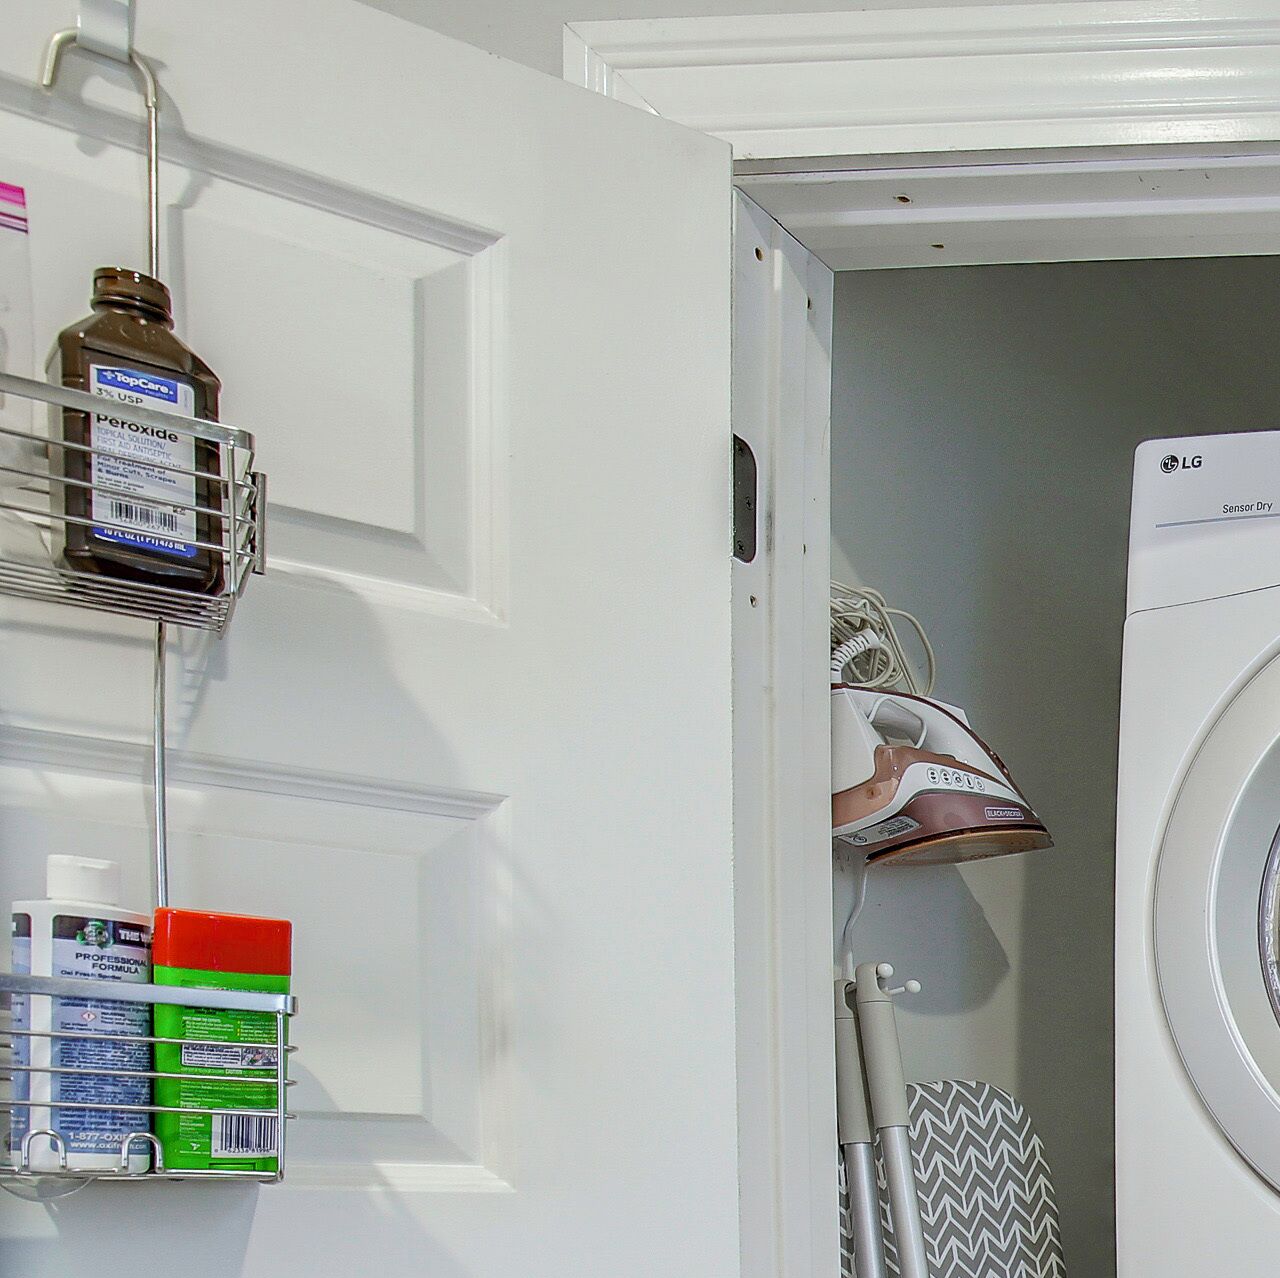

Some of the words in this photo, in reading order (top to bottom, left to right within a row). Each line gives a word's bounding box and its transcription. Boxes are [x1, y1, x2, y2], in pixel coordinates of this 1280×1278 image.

[115, 371, 170, 395] TopCare
[97, 387, 114, 398] 3%
[118, 392, 143, 404] USP
[97, 413, 178, 442] Peroxide
[97, 427, 125, 439] TOPICAL
[97, 437, 116, 446] FIRST
[120, 440, 131, 448] AID
[133, 444, 172, 459] ANTISEPTIC
[1182, 456, 1202, 469] LG
[1223, 504, 1254, 514] Sensor
[1257, 502, 1273, 512] Dry
[75, 952, 148, 967] PROFESSIONAL
[92, 963, 140, 975] FORMULA
